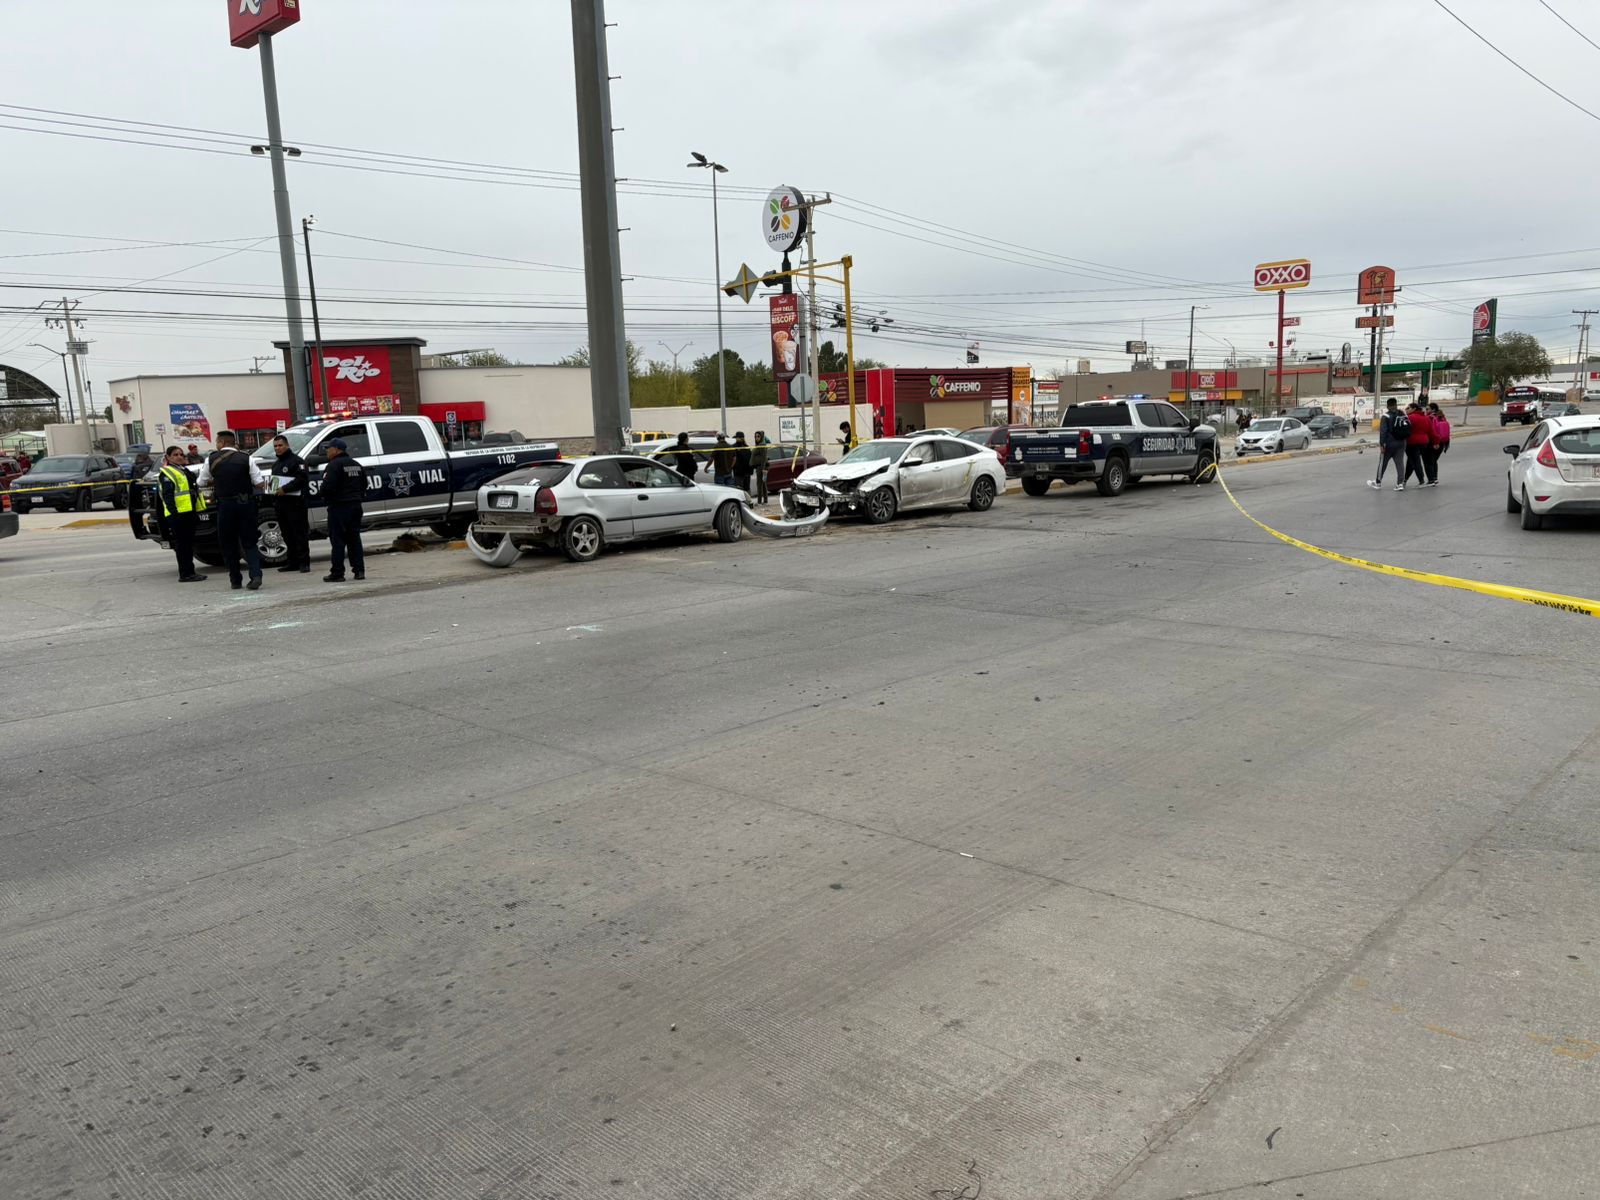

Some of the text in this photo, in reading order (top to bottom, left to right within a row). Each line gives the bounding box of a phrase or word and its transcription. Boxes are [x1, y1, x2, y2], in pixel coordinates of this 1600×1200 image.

[768, 231, 795, 243] CAFFENIO
[1256, 265, 1306, 285] OXXO
[322, 355, 365, 368] Del
[335, 367, 381, 383] Rio
[944, 382, 981, 393] CAFFENIO
[1143, 438, 1175, 451] SEGURIDAD
[497, 454, 516, 465] 1102
[418, 468, 446, 484] VIAL
